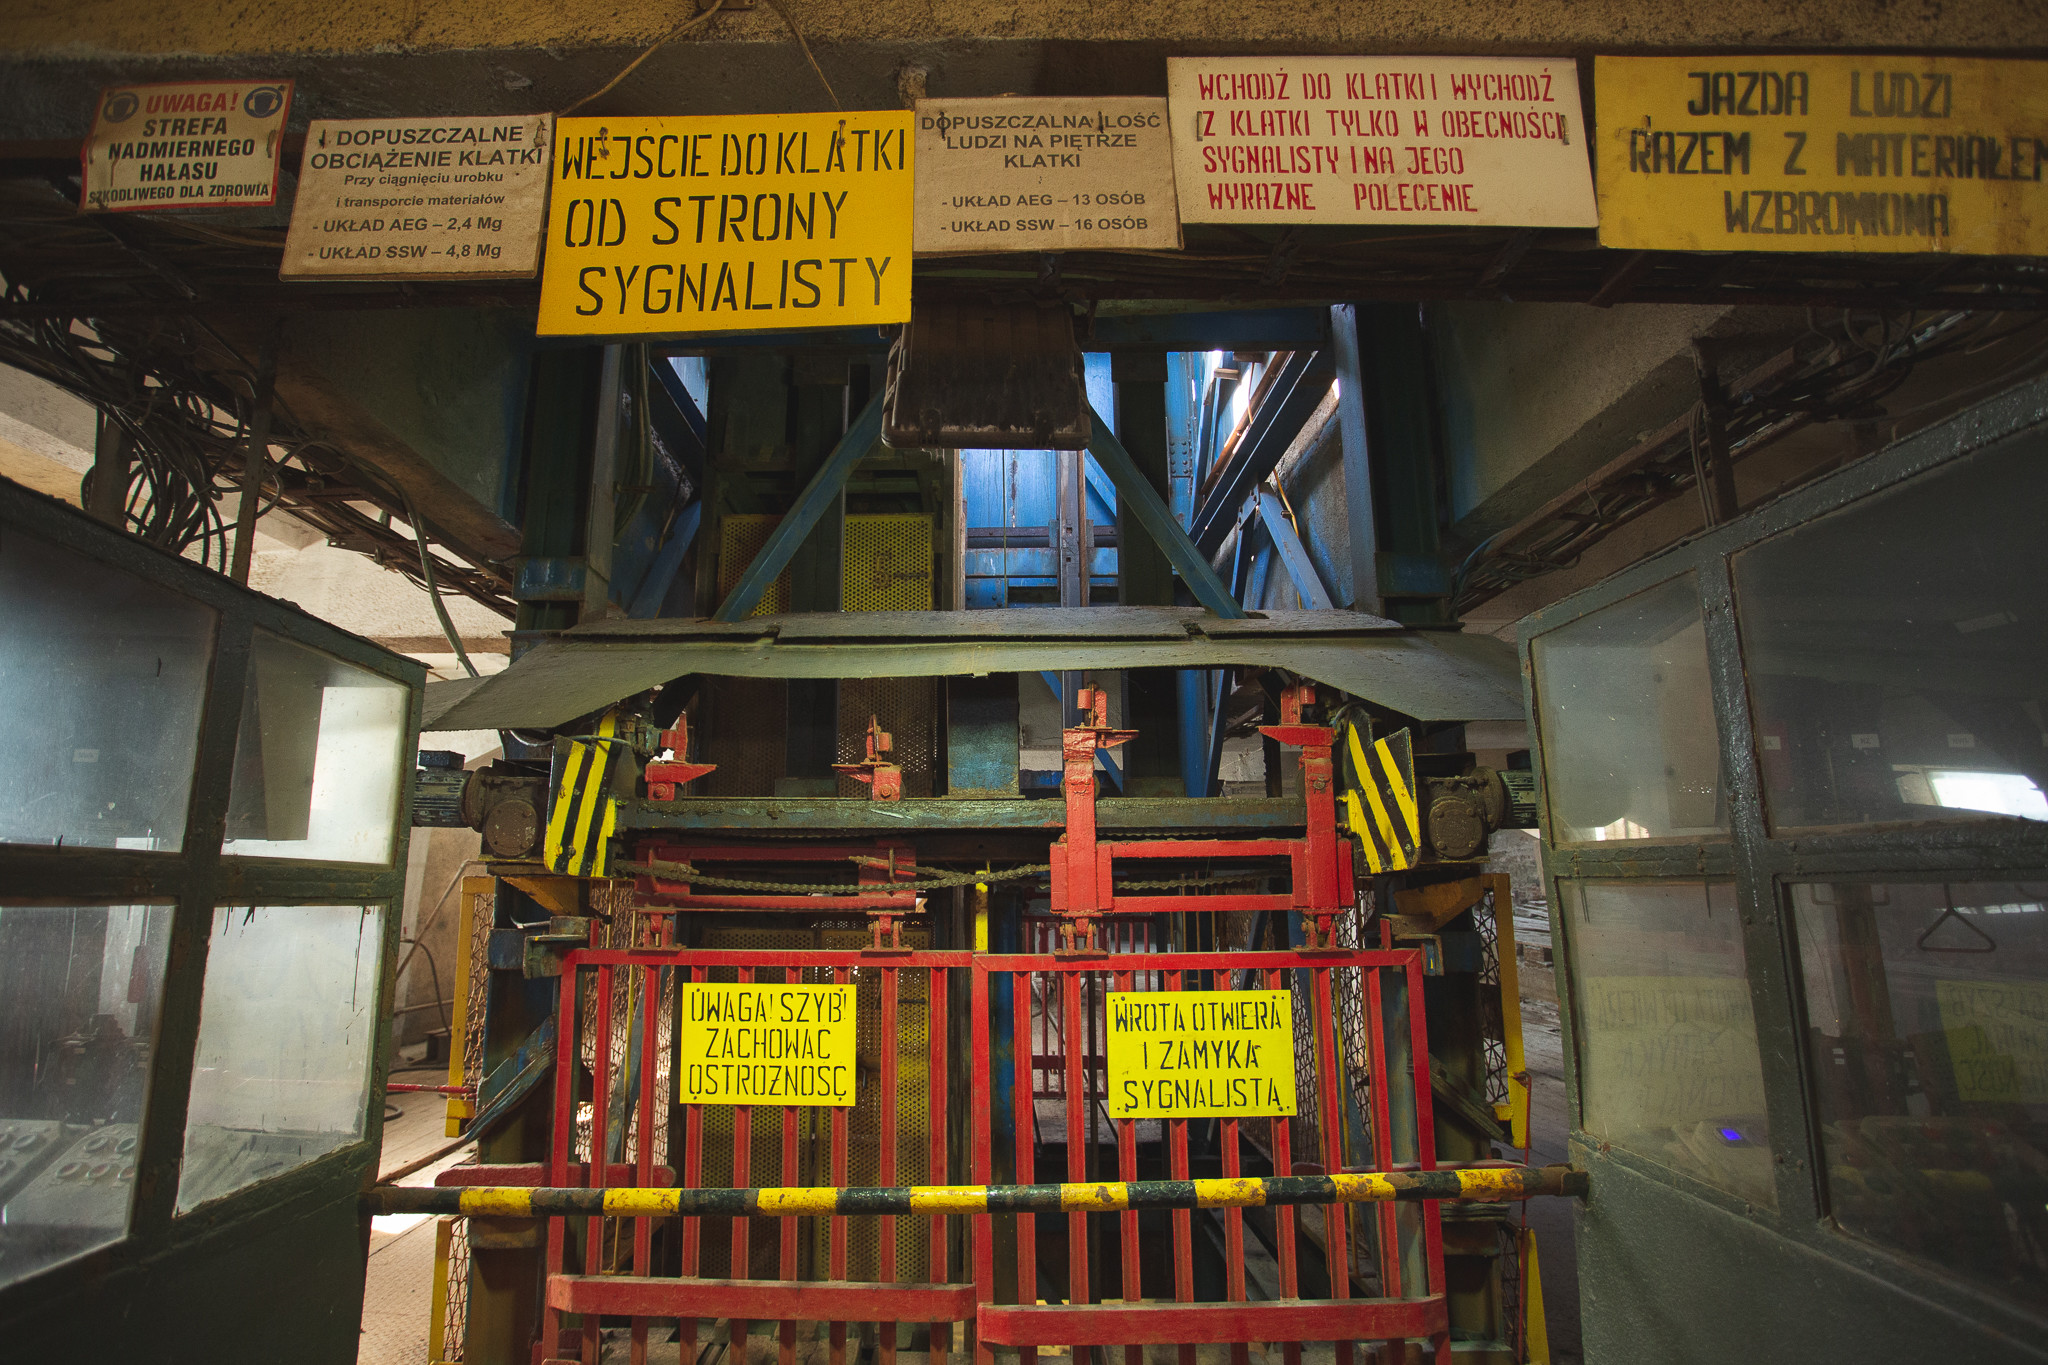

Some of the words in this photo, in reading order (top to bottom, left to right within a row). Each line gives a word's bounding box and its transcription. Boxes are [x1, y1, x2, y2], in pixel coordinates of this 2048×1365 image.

[1199, 68, 1289, 100] WCHODŹ
[1303, 73, 1330, 100] DO
[1346, 73, 1425, 100] KLATKI
[1430, 73, 1437, 100] I
[1450, 69, 1555, 102] WYCHODŹ
[1687, 71, 1809, 116] JAZDA
[1850, 71, 1952, 119] LUDZI
[145, 92, 239, 114] UWAGA!
[143, 117, 227, 137] STREFA
[922, 115, 1092, 130] DOPUSZCZALNA
[1203, 110, 1216, 137] Z
[1230, 110, 1310, 137] KLATKI
[1326, 110, 1399, 137] TYLKO
[1413, 110, 1429, 137] W
[1442, 106, 1564, 139] OBECNOŚCI
[337, 126, 523, 146] DOPUSZCZALNE
[947, 135, 1006, 150] LUDZI
[1014, 135, 1044, 148] NA
[1050, 134, 1137, 151] PIĘTRZE
[108, 139, 255, 160] NADMIERNEGO
[311, 149, 452, 172] OBCIĄŻENIE
[458, 148, 542, 167] KLATKI
[721, 133, 766, 176] DO
[776, 129, 905, 175] KLATKI
[1004, 154, 1080, 168] KLATKI
[1202, 146, 1339, 174] SYGNALISTY
[1350, 146, 1358, 174] I
[1363, 148, 1394, 174] NA
[1407, 147, 1464, 175] JEGO
[1629, 129, 1750, 175] RAZEM
[1784, 132, 1807, 175] Z
[140, 162, 218, 181] HAŁASU
[344, 175, 375, 187] Przy
[379, 172, 449, 186] ciągnięciu
[454, 172, 503, 183] urobku
[89, 186, 174, 203] SZKODLIWEGO
[180, 185, 204, 198] DLA
[209, 183, 269, 197] ZDROWIA
[336, 197, 340, 207] i
[345, 196, 424, 210] transporcie
[428, 194, 505, 206] materiałów
[952, 196, 1011, 207] UKŁAD
[1016, 194, 1052, 206] AEG
[1072, 194, 1090, 205] 13
[1096, 191, 1145, 205] OSÓB
[1353, 183, 1478, 212] POLECENIE
[323, 220, 384, 232] UKŁAD
[389, 218, 427, 231] AEG
[447, 217, 471, 231] 2,4
[478, 217, 502, 231] Mg
[565, 198, 626, 247] OD
[652, 191, 848, 245] STRONY
[951, 220, 1011, 232] UKŁAD
[1016, 220, 1055, 231] SSW
[1075, 219, 1092, 230] 16
[1098, 215, 1148, 230] OSÓB
[1724, 190, 1950, 237] WZBRONIONA
[319, 246, 381, 259] UKŁAD
[385, 245, 427, 259] SSW
[446, 245, 470, 258] 4,8
[476, 244, 501, 259] Mg
[576, 256, 892, 316] SYGNALISTY
[691, 991, 773, 1022] UWAGA!
[781, 992, 847, 1022] SZYB!
[1115, 1003, 1185, 1032] WROTA
[1193, 1001, 1281, 1031] OTWIERA
[1143, 1042, 1148, 1069] I
[1159, 1040, 1259, 1070] ZAMYKA
[1124, 1078, 1280, 1109] SYGNALISTA
